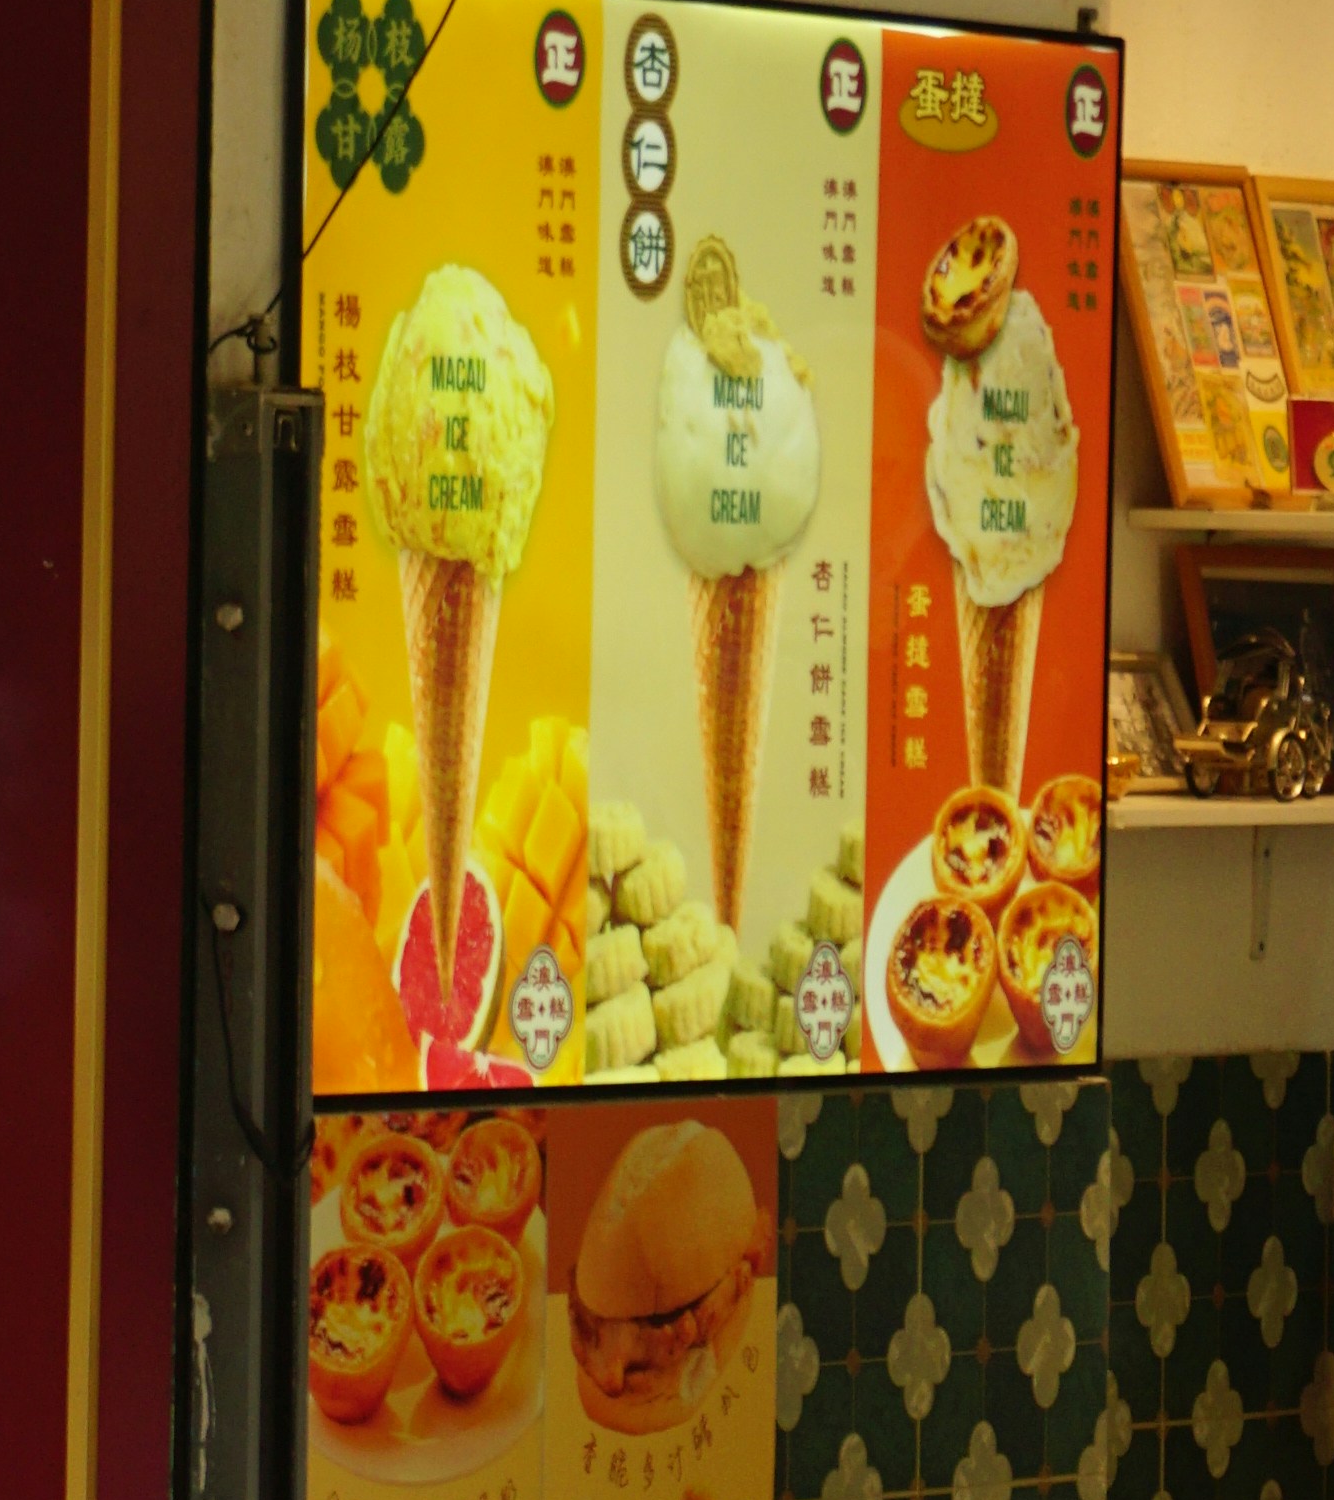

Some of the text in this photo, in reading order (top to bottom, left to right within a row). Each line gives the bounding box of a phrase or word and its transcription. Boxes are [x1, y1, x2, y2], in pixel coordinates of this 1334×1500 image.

[910, 69, 987, 125] 蛋撻
[630, 42, 671, 275] 杏仁餅
[431, 356, 487, 392] MACAU
[713, 375, 765, 411] MACAU
[982, 387, 1030, 424] MACAU
[331, 294, 362, 602] 楊枝甘露雪糕
[445, 416, 469, 452] ICE
[726, 432, 749, 468] ICE
[994, 443, 1015, 478] ICE
[429, 474, 484, 511] CREAM
[710, 488, 762, 525] CREAM
[981, 498, 1027, 533] CREAM
[809, 560, 834, 798] 杏仁餅雪糕
